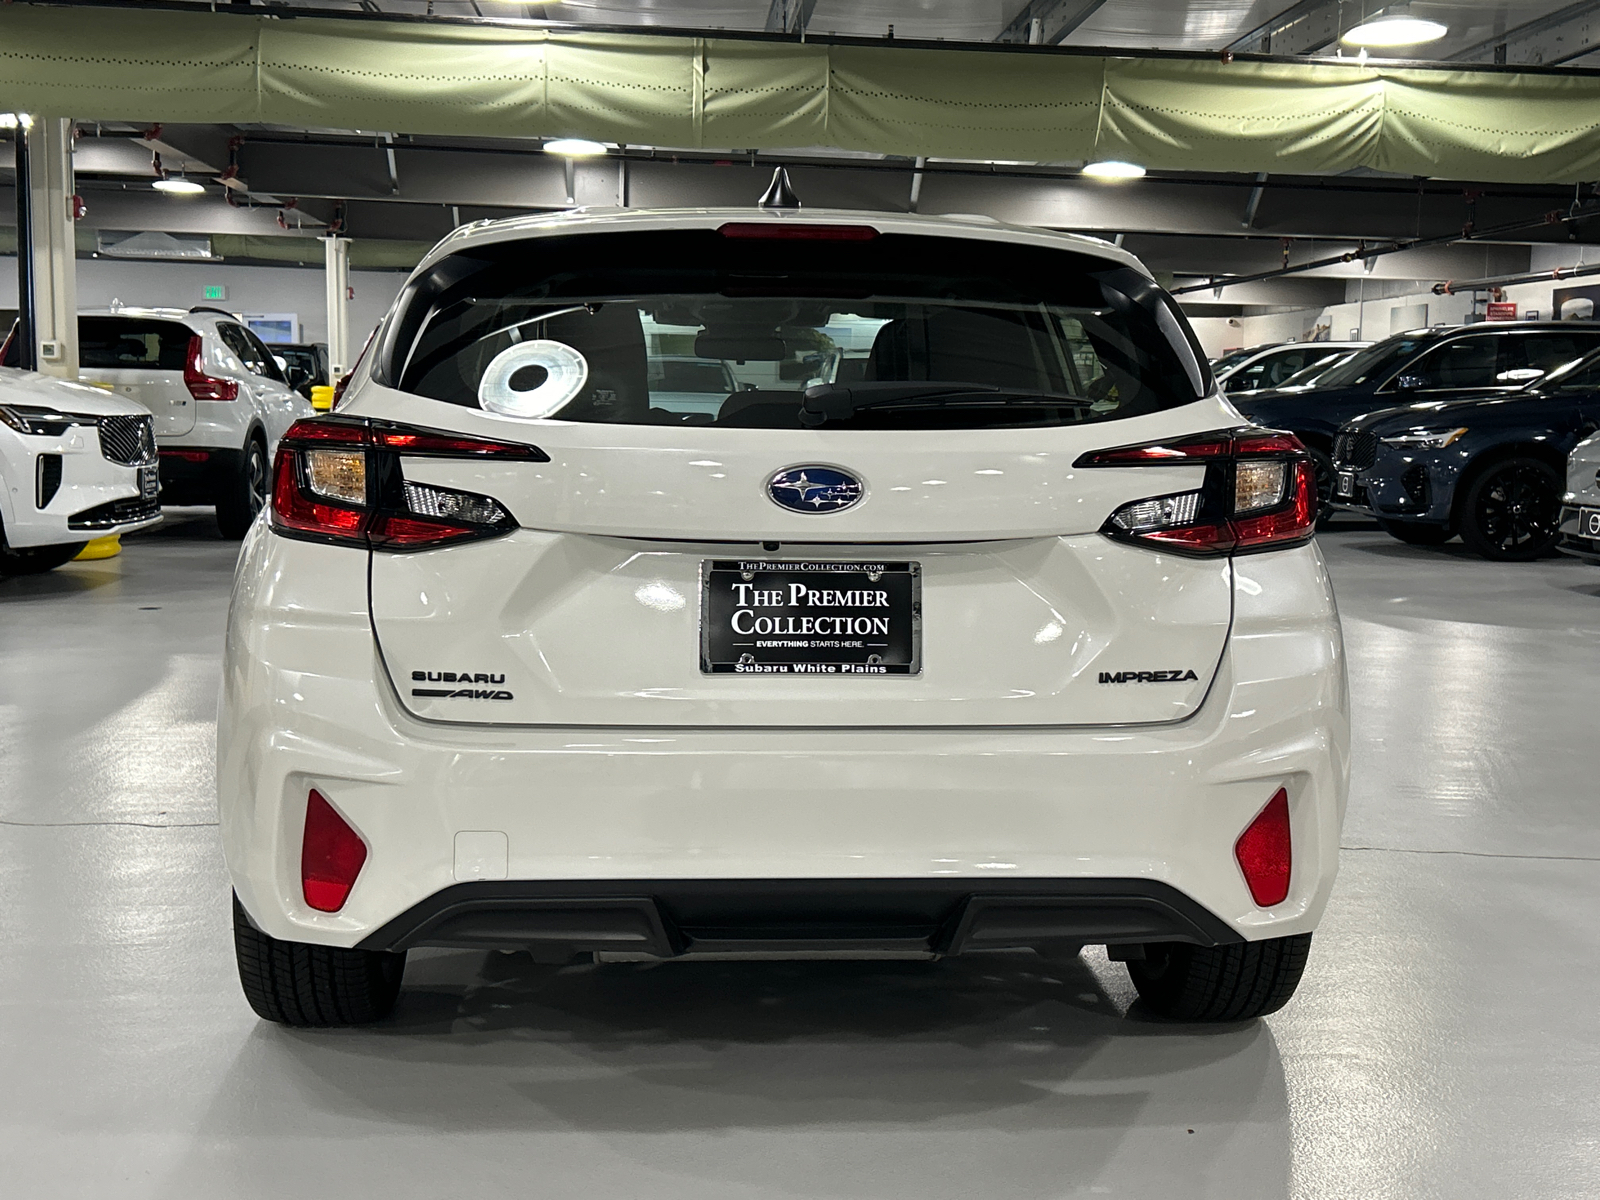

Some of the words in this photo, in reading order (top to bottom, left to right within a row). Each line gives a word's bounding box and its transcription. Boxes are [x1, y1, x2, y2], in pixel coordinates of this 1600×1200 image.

[205, 285, 222, 299] EXIT
[731, 583, 784, 607] THE
[788, 583, 889, 607] PREMIER
[731, 609, 889, 635] COLLECTION
[756, 640, 809, 648] EVERYTHING
[810, 640, 839, 648] STARTS
[841, 640, 865, 648] HERE.
[735, 664, 788, 673] Subaru
[793, 664, 836, 673] White
[841, 664, 887, 673] Plains
[412, 670, 505, 684] SUBARU
[1098, 669, 1199, 684] IMPREZA
[449, 689, 514, 700] AWD
